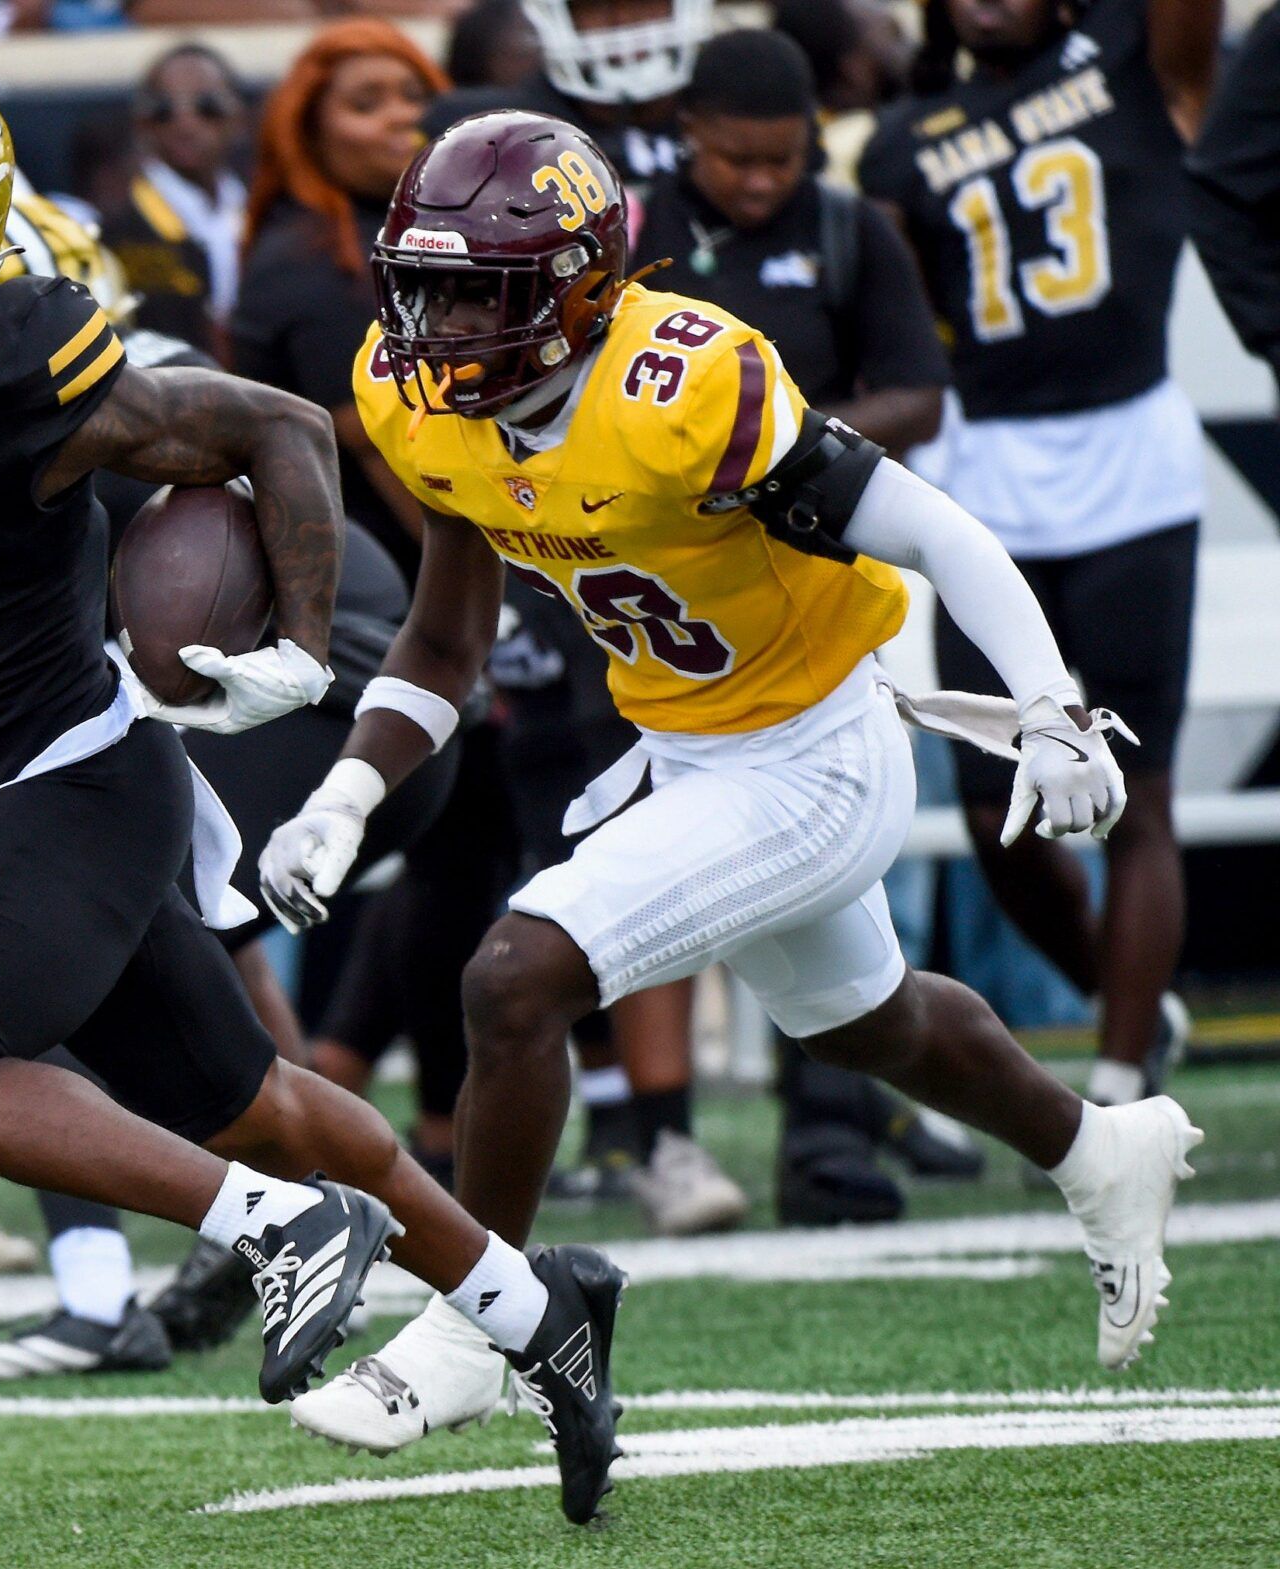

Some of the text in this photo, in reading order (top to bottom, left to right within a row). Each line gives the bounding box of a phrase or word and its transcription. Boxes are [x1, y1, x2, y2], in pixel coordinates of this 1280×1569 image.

[531, 150, 606, 232] 38
[405, 233, 455, 250] Riddell
[948, 135, 1113, 344] 13
[622, 309, 730, 408] 38
